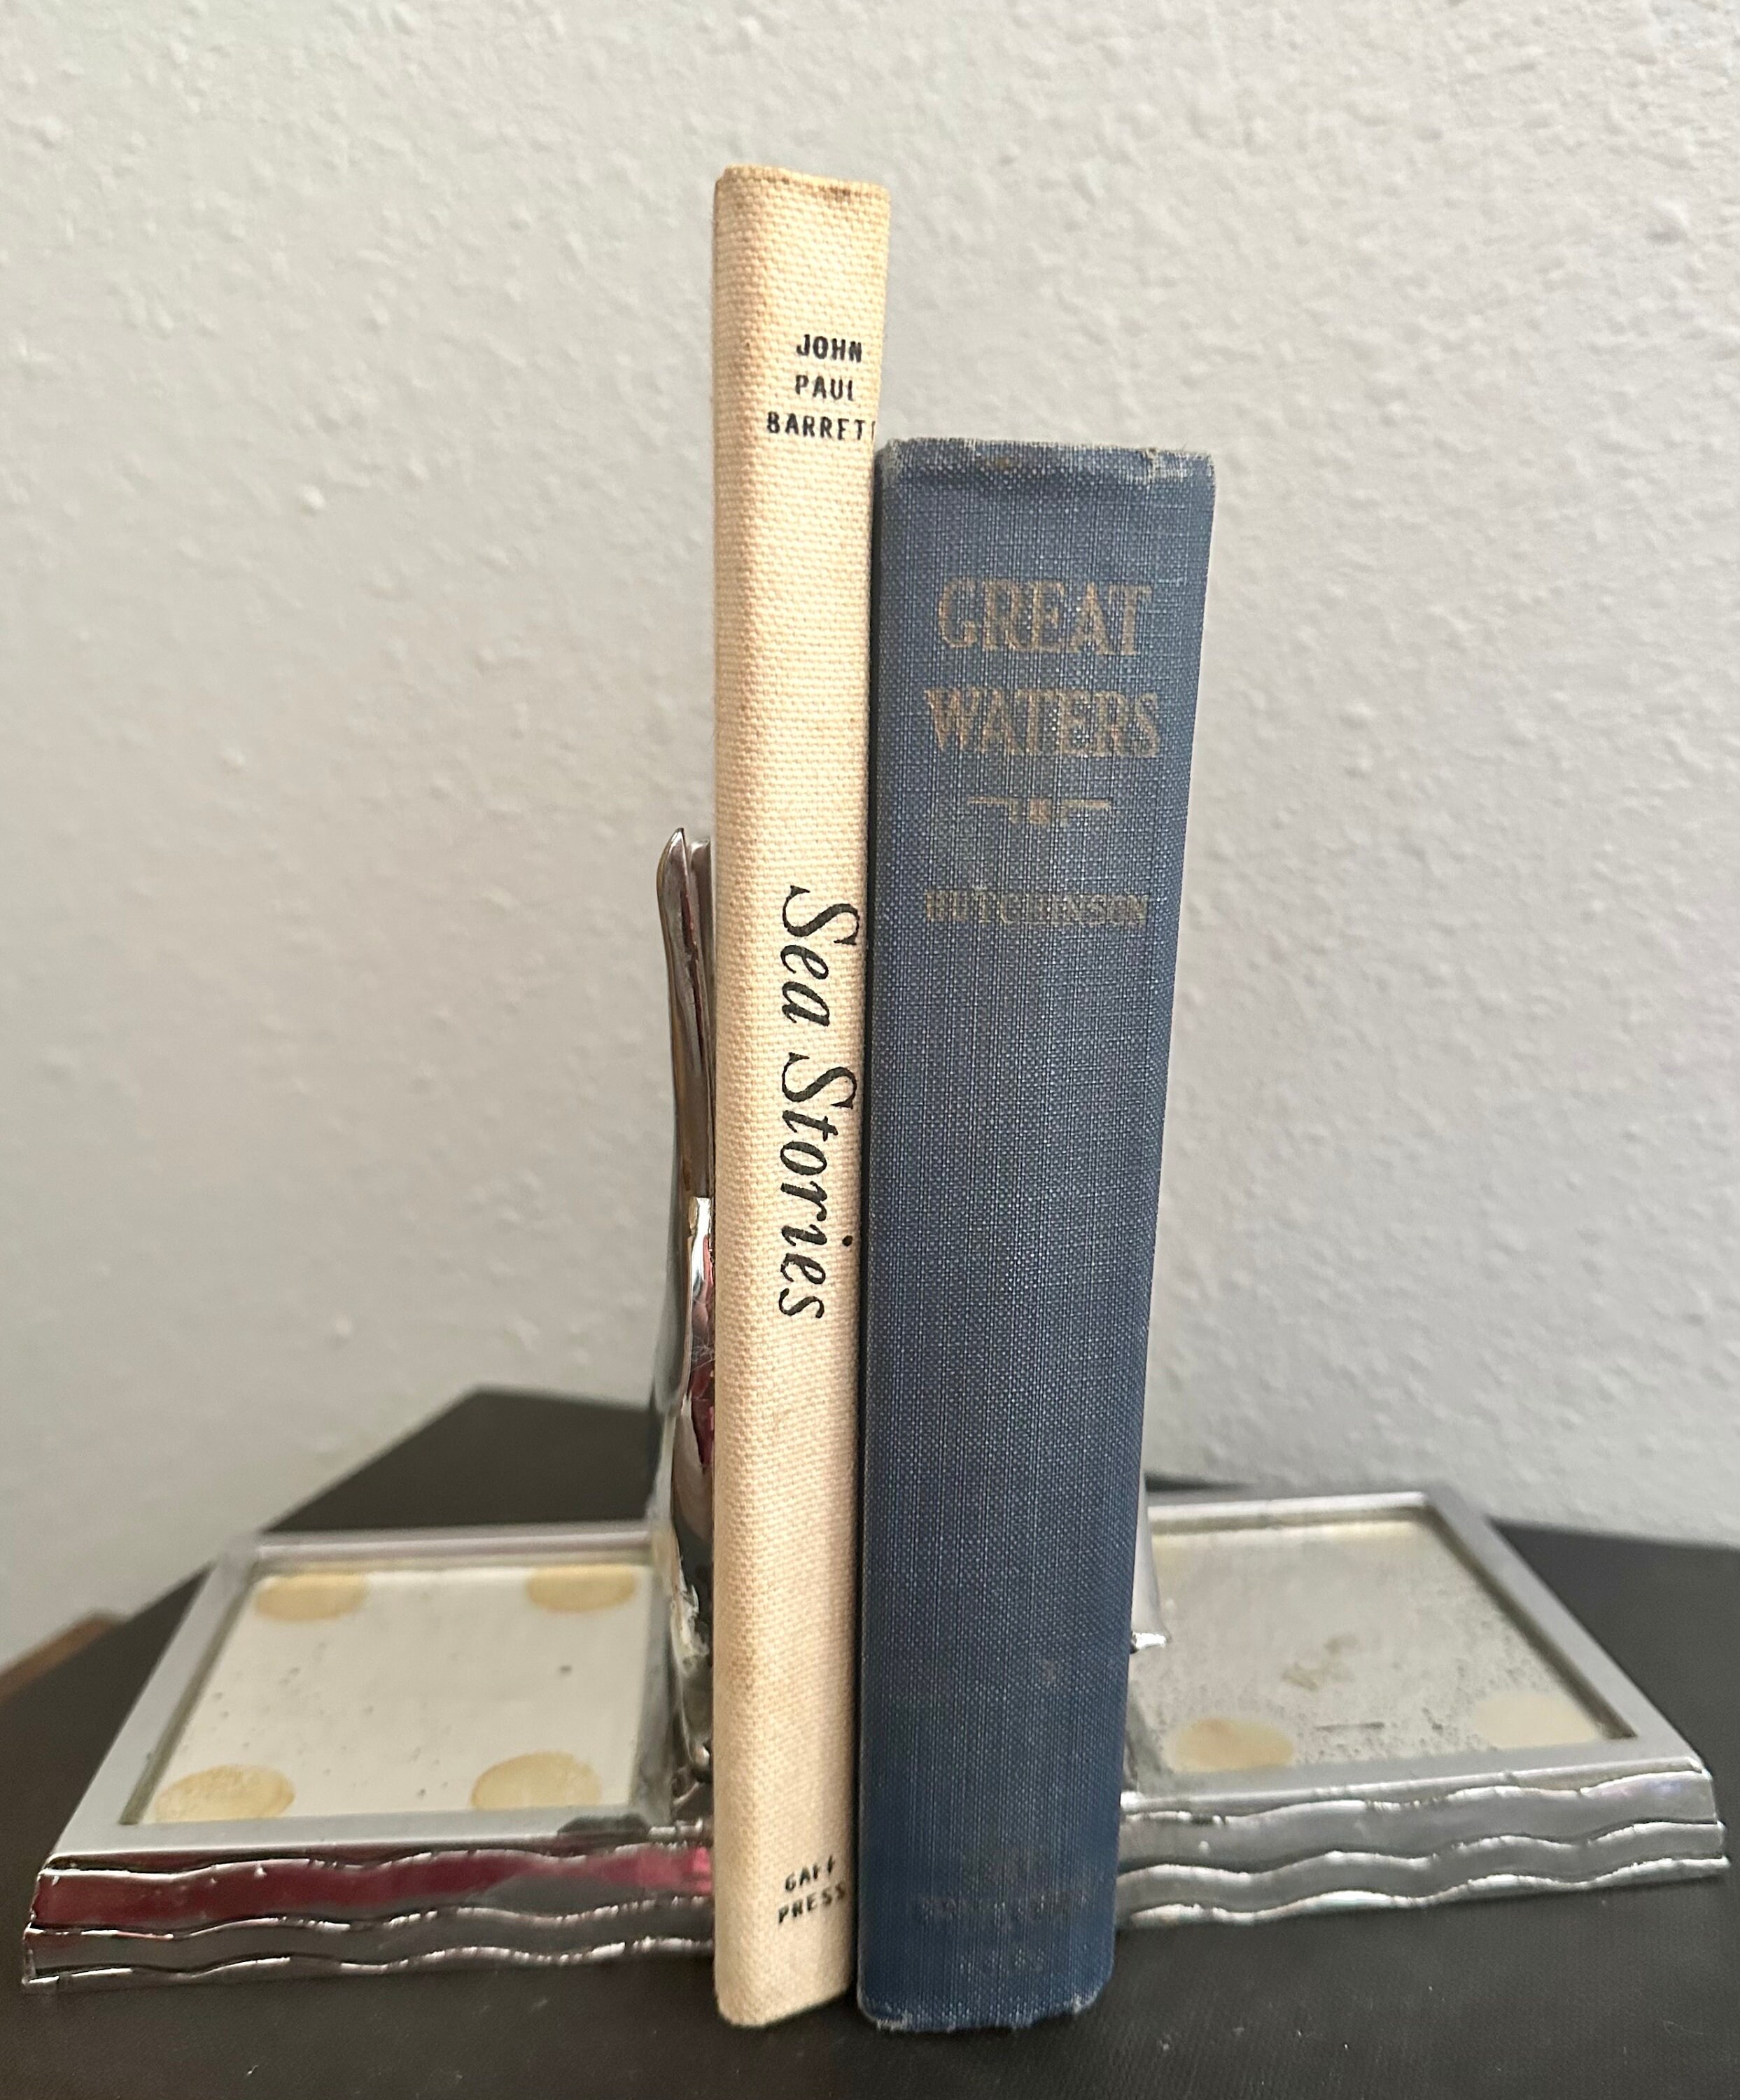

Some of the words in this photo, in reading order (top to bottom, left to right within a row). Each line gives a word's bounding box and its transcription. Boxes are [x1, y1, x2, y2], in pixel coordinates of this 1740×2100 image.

[796, 333, 862, 363] JOHN
[795, 374, 854, 401] PAUL
[937, 577, 1153, 656] GREAT
[924, 687, 1161, 758] WATERS
[780, 886, 860, 1027] Sea
[778, 1052, 858, 1320] Stories
[778, 1880, 846, 1925] PRESS
